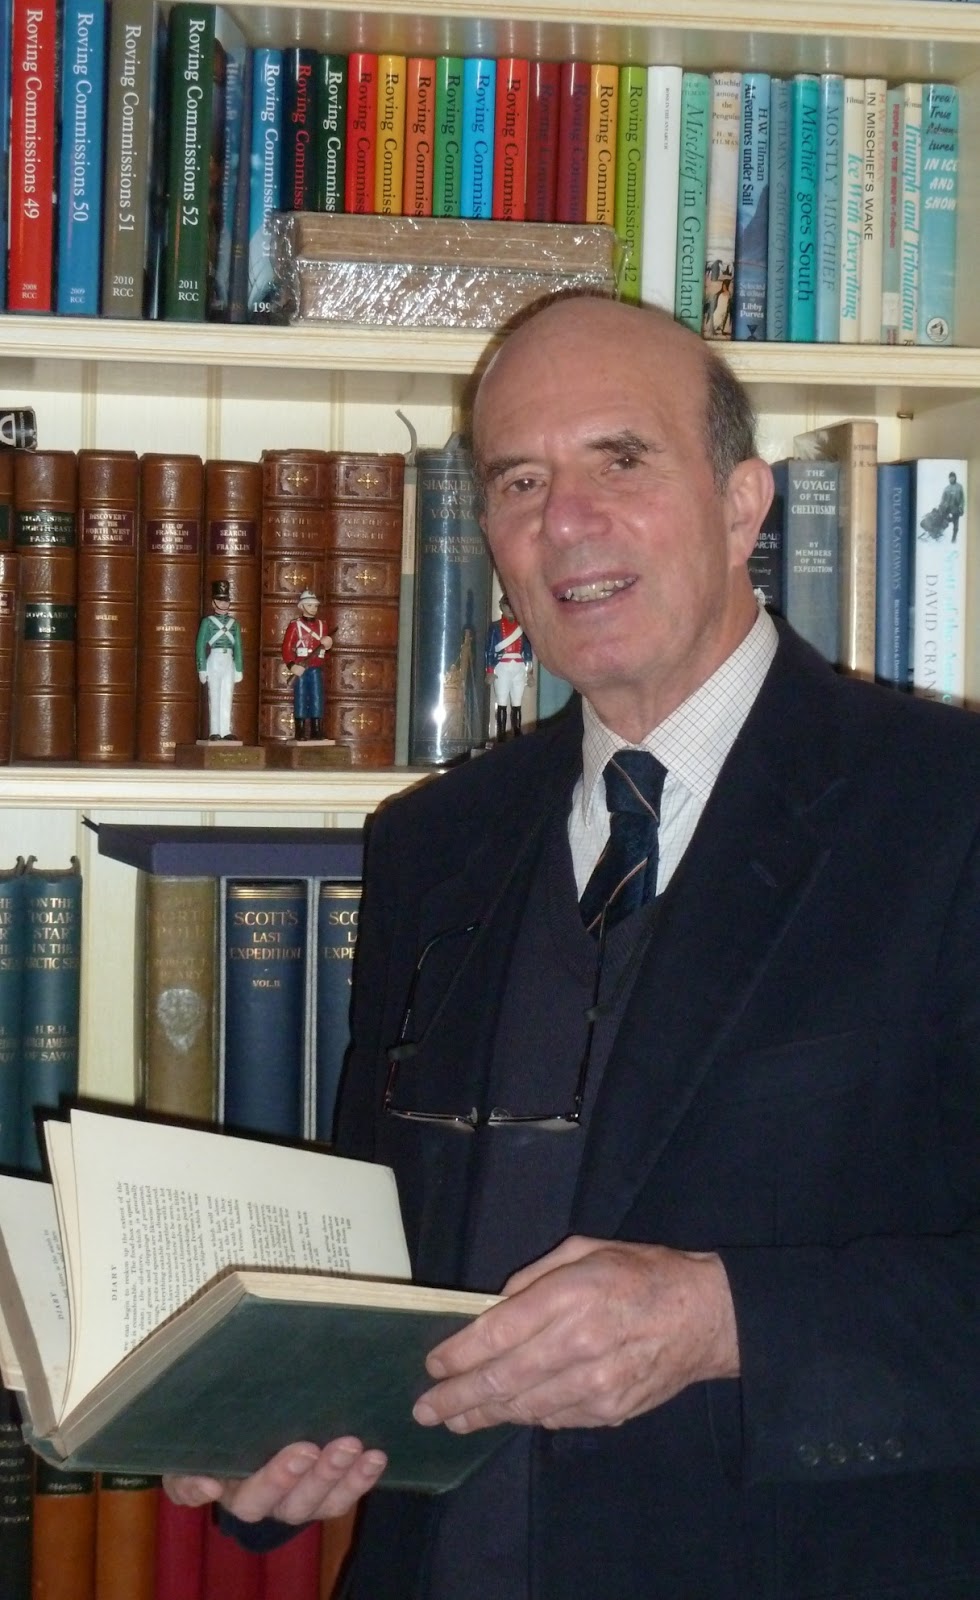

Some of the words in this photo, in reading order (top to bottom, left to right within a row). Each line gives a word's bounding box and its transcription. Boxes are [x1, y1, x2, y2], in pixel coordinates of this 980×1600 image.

[23, 9, 43, 72] Roving
[73, 13, 94, 75] Roving
[120, 24, 142, 88] Roving
[184, 19, 206, 82] Roving
[260, 63, 280, 122] Roving
[292, 64, 313, 124] Roving
[322, 70, 343, 131] Roving
[353, 72, 372, 132] Roving
[381, 73, 399, 131] Roving
[412, 76, 432, 135] Roving
[441, 74, 461, 136] Roving
[472, 75, 490, 135] Roving
[502, 79, 521, 138] Roving
[535, 84, 554, 141] Roving
[567, 84, 588, 142] Roving
[596, 85, 614, 144] Roving
[625, 85, 643, 143] Roving
[721, 101, 733, 109] the
[742, 83, 757, 146] Adventures
[866, 92, 876, 106] IN
[930, 106, 952, 119] True
[23, 76, 43, 194] Commissions
[73, 79, 92, 197] Commissions
[119, 92, 140, 208] Commissions
[183, 86, 204, 201] Commissions
[680, 103, 704, 181] Mischief
[742, 148, 755, 178] under
[756, 140, 768, 182] Tilman
[801, 103, 818, 184] Mischief
[824, 106, 840, 184] MOSTLY
[864, 112, 876, 193] MISCHIEF'S
[902, 124, 921, 194] Triumph
[294, 130, 310, 210] Commiss
[325, 136, 342, 212] Commiss
[355, 137, 371, 212] Commiss
[382, 138, 398, 214] Commiss
[414, 141, 430, 217] Commiss
[443, 141, 459, 217] Commiss
[473, 140, 489, 218] Commiss
[503, 143, 519, 219] Commiss
[596, 150, 612, 225] Commiss
[847, 153, 863, 178] Ice
[923, 158, 939, 171] IN
[940, 159, 958, 172] ICE
[929, 177, 955, 190] AND
[23, 197, 40, 219] 49
[72, 201, 89, 222] 50
[118, 212, 135, 231] 51
[182, 206, 199, 226] 52
[625, 148, 641, 256] Commission
[683, 188, 701, 208] in
[741, 183, 754, 206] Sail
[796, 191, 815, 235] goes
[846, 184, 862, 225] With
[863, 197, 875, 241] WAKE
[904, 200, 921, 233] and
[924, 196, 957, 210] SNOW
[680, 214, 700, 319] Greenland
[797, 241, 814, 302] South
[822, 194, 839, 292] MISCHIEF
[70, 296, 85, 304] RCC
[112, 287, 134, 297] RCC
[113, 275, 134, 285] 2010
[178, 280, 199, 290] 2011
[178, 292, 199, 301] RCC
[624, 263, 638, 283] 42
[843, 229, 862, 321] Everything
[902, 240, 919, 331] Tribulation
[252, 303, 272, 313] 199
[740, 310, 764, 319] Purves
[742, 302, 762, 311] Libby
[792, 480, 837, 491] VOYAGE
[799, 493, 811, 501] OF
[813, 493, 831, 502] THE
[806, 469, 826, 477] THE
[85, 527, 109, 535] NORTH
[431, 508, 475, 520] VOYAG
[891, 487, 902, 522] POLAR
[793, 565, 834, 574] EXPEDITION
[795, 549, 832, 557] MEMBERS
[890, 527, 903, 590] CASTAWAYS
[924, 573, 938, 632] DAVID
[922, 639, 939, 700] CRAN
[31, 910, 74, 925] POLAR
[50, 897, 75, 909] THE
[233, 909, 299, 927] SCOTT'S
[33, 927, 71, 940] STAR
[33, 943, 47, 954] IN
[49, 943, 73, 954] THE
[229, 947, 302, 960] EXPEDITION
[252, 931, 282, 943] LAST
